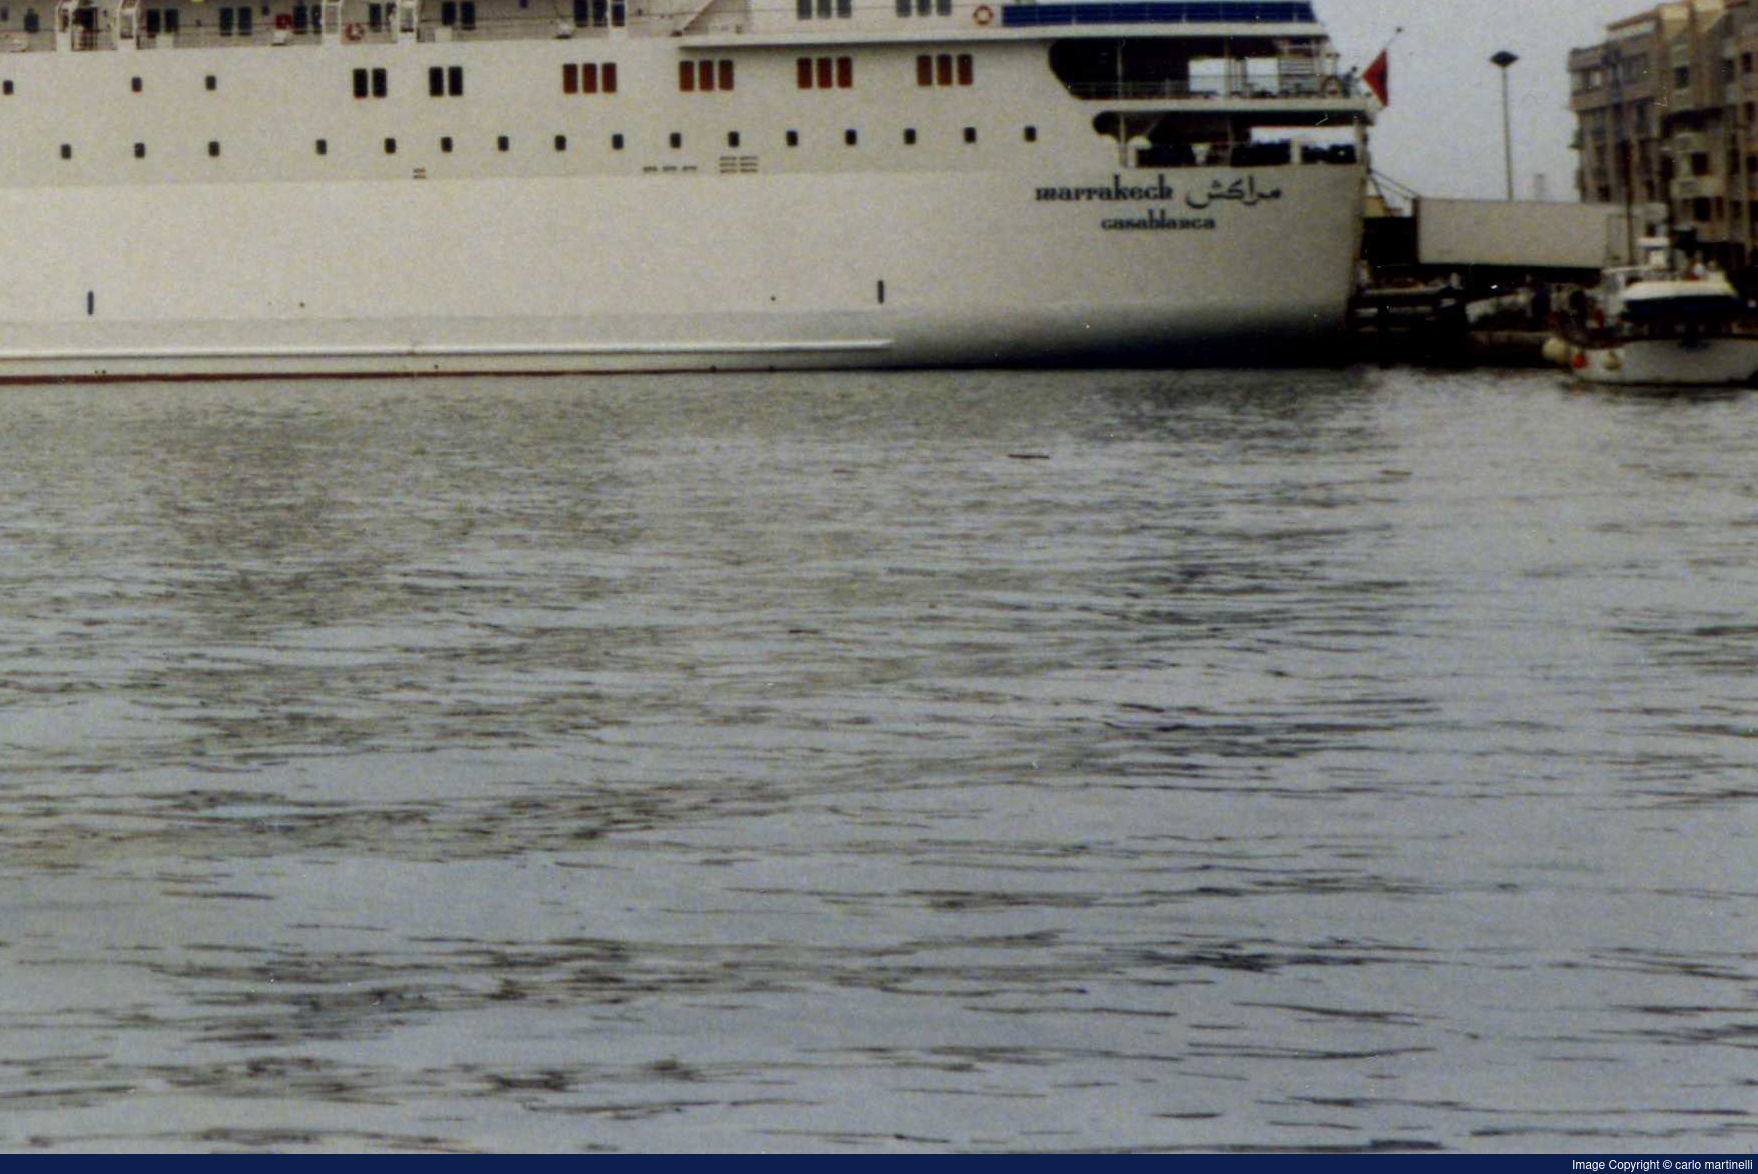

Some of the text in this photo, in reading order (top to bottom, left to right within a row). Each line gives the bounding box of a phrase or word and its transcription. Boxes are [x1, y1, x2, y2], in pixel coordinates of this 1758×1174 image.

[1035, 174, 1173, 202] marrakech
[1185, 174, 1282, 209] مراكش
[1101, 209, 1216, 231] casablanca
